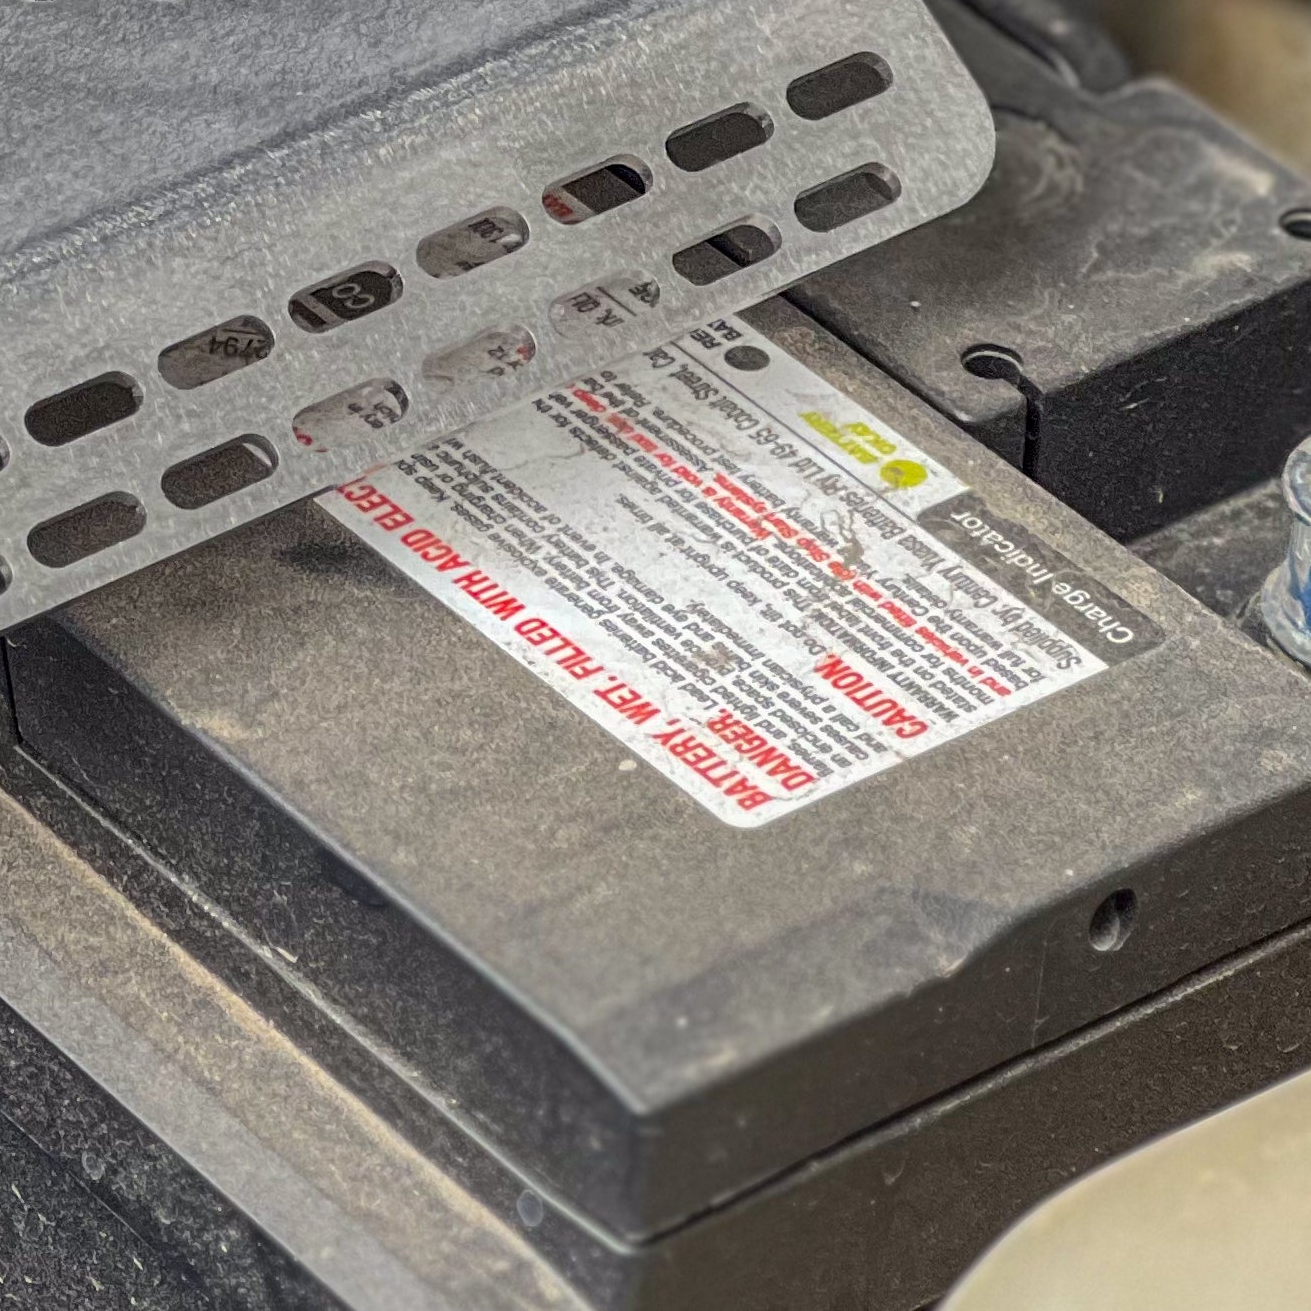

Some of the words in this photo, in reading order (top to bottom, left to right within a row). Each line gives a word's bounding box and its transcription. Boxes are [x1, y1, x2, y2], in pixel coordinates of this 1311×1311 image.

[596, 369, 618, 383] to
[663, 362, 722, 401] Street,
[597, 390, 627, 409] the
[610, 381, 652, 408] Refer
[545, 411, 573, 428] for
[704, 394, 762, 432] Cobalt
[565, 425, 618, 463] defects
[567, 406, 640, 456] passenger
[625, 432, 659, 454] taxi
[633, 417, 715, 474] Assessment
[647, 405, 721, 457] procedure.
[745, 424, 801, 461] 49-65
[796, 409, 881, 465] BATTERY
[431, 449, 497, 495] sulphuric
[458, 449, 500, 477] flush
[631, 454, 682, 488] private
[650, 451, 678, 468] for
[668, 464, 704, 488] void
[708, 453, 743, 476] test
[786, 456, 826, 479] Ltd
[411, 474, 453, 503] Keep
[432, 470, 455, 484] or
[487, 472, 549, 515] accident
[610, 459, 665, 496] against
[697, 485, 718, 498] is
[709, 470, 770, 514] systems.
[734, 472, 788, 509] battery
[448, 481, 512, 525] charging
[610, 492, 655, 524] times.
[671, 486, 699, 504] for
[447, 500, 495, 533] gases.
[488, 492, 547, 534] contains
[537, 512, 563, 526] of
[645, 521, 671, 536] all
[654, 494, 724, 543] warranted
[691, 499, 759, 546] purchase
[710, 494, 776, 540] Warranty
[758, 511, 801, 539] Start
[777, 504, 842, 549] warranty
[833, 490, 908, 541] Batteries
[398, 526, 471, 574] ACID
[484, 530, 551, 578] explosive
[500, 523, 544, 554] When
[538, 531, 593, 569] battery
[554, 523, 599, 553] event
[661, 532, 686, 548] at
[714, 540, 738, 554] is
[746, 543, 771, 557] of
[792, 535, 833, 563] Stop
[892, 533, 948, 572] Yuasa
[943, 508, 1058, 585] Indicator
[538, 551, 594, 591] battery.
[590, 549, 613, 565] In
[677, 544, 731, 582] upright
[728, 548, 791, 590] product
[762, 554, 800, 580] date
[770, 539, 855, 598] applications.
[450, 568, 528, 621] WITH
[582, 565, 618, 591] This
[606, 560, 668, 605] damage.
[722, 578, 764, 607] keep
[792, 576, 832, 603] from
[849, 579, 884, 602] with
[896, 572, 950, 610] details.
[928, 562, 1003, 609] Century
[541, 575, 608, 620] generate
[583, 587, 622, 614] from
[659, 602, 693, 623] eye
[755, 602, 785, 623] tilt,
[779, 587, 814, 612] This
[872, 575, 933, 617] Century
[1045, 579, 1140, 645] Charge
[612, 587, 685, 641] ventilation.
[615, 611, 658, 639] away
[681, 597, 768, 661] immediately.
[775, 619, 808, 639] not
[821, 600, 863, 627] label
[843, 596, 926, 653] commercial
[875, 599, 919, 628] fitted
[923, 614, 954, 634] the
[941, 606, 1006, 651] warranty
[986, 601, 1029, 627] by:
[511, 615, 606, 680] FILLED
[595, 617, 659, 663] batteries
[680, 620, 717, 643] and
[799, 635, 828, 656] Do
[854, 623, 894, 651] front
[911, 625, 971, 667] vehicles
[947, 630, 990, 659] upon
[1006, 618, 1086, 671] Supplied
[647, 659, 687, 685] acid
[648, 636, 719, 687] cigarettes
[886, 648, 917, 668] the
[911, 665, 936, 681] on
[917, 651, 946, 669] for
[963, 664, 986, 678] in
[978, 656, 1030, 691] based
[995, 648, 1027, 668] full
[1018, 665, 1048, 683] for
[676, 681, 720, 710] Lead
[728, 674, 777, 710] space,
[745, 668, 782, 693] skin
[758, 657, 830, 706] physician
[808, 653, 931, 740] CAUTION.
[884, 669, 961, 723] WARRANTY
[926, 679, 978, 714] stated
[938, 666, 996, 706] months
[976, 675, 1013, 698] and
[588, 674, 663, 725] WET.
[707, 683, 763, 721] lighted
[774, 689, 825, 725] severe
[820, 703, 838, 714] a
[752, 718, 788, 741] and
[766, 707, 835, 755] enclosed
[827, 712, 861, 733] call
[695, 707, 818, 791] DANGER.
[781, 737, 836, 778] flames,
[817, 723, 871, 761] causes
[851, 731, 890, 754] and
[644, 716, 778, 811] BATTERY,
[827, 752, 854, 769] an
